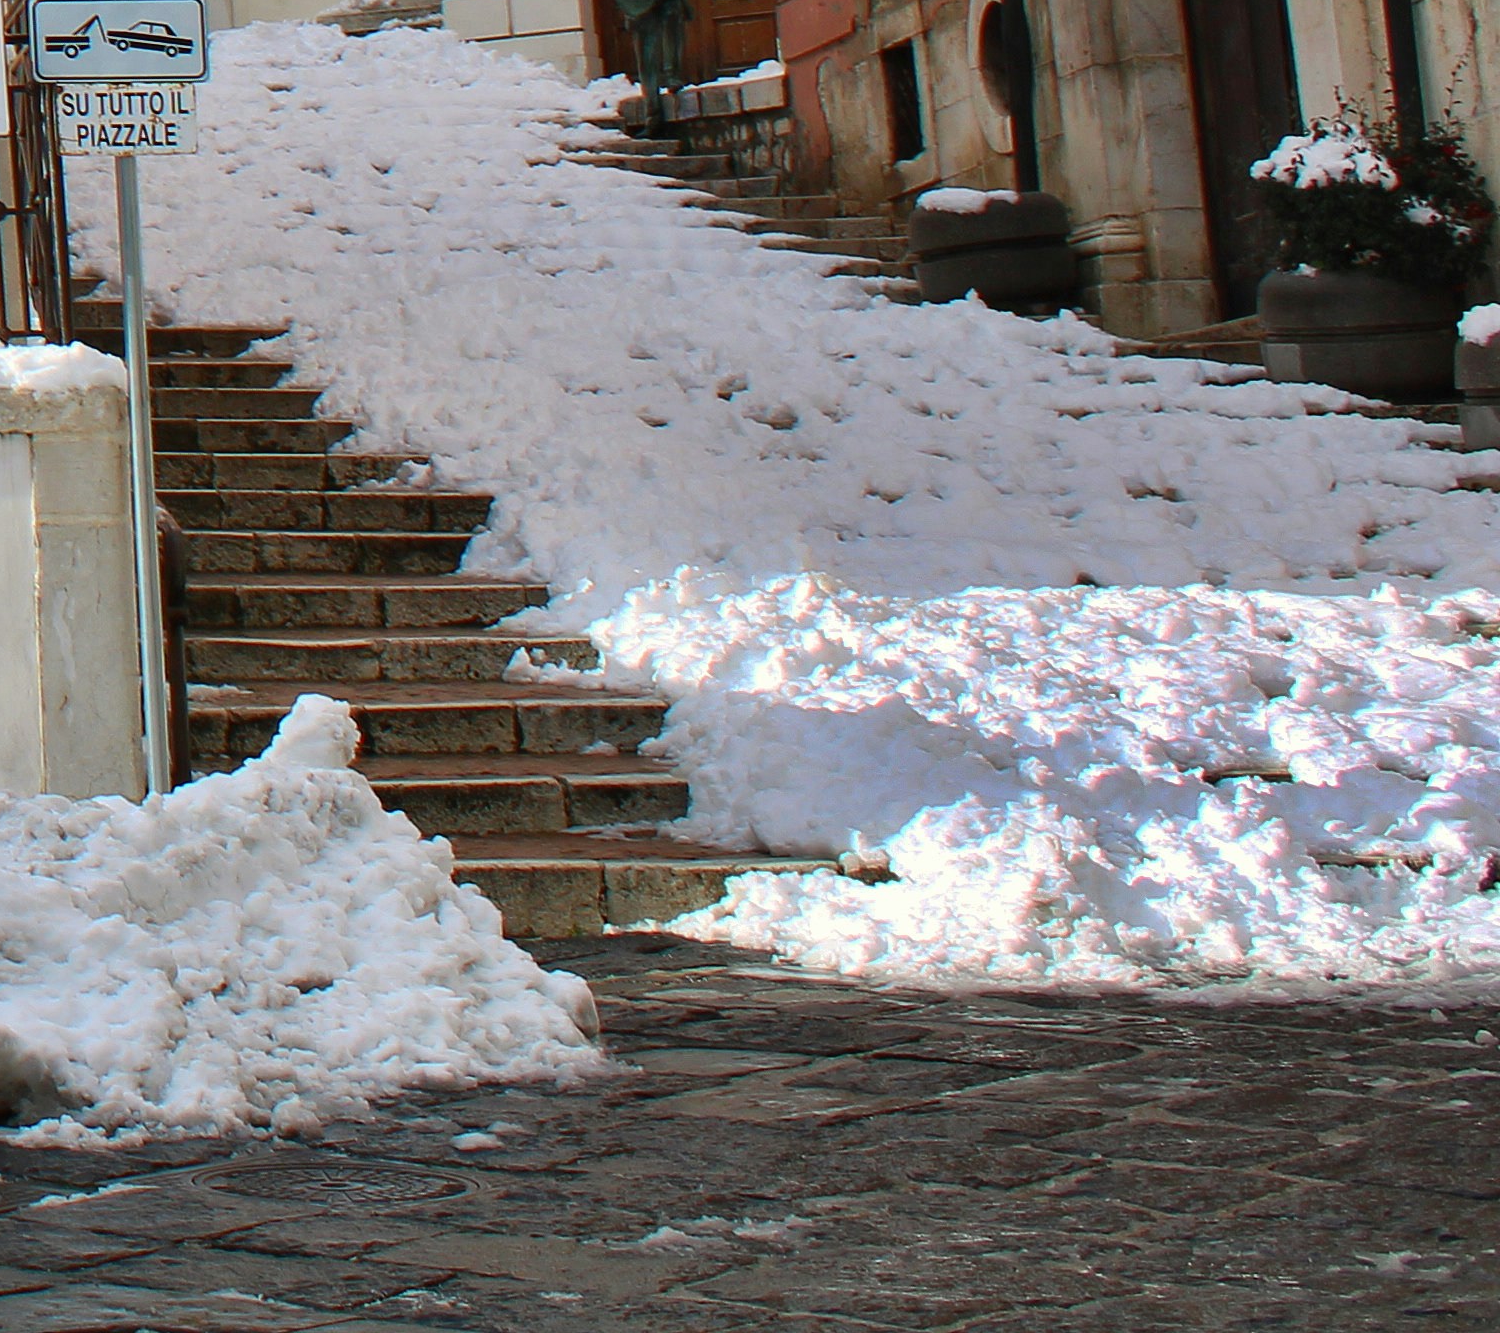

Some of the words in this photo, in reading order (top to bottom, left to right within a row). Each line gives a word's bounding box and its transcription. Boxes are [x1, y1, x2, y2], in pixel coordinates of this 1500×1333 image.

[61, 91, 90, 116] SU
[95, 91, 165, 116] TUTTO
[170, 91, 190, 115] IL
[76, 122, 178, 147] PIAZZALE
